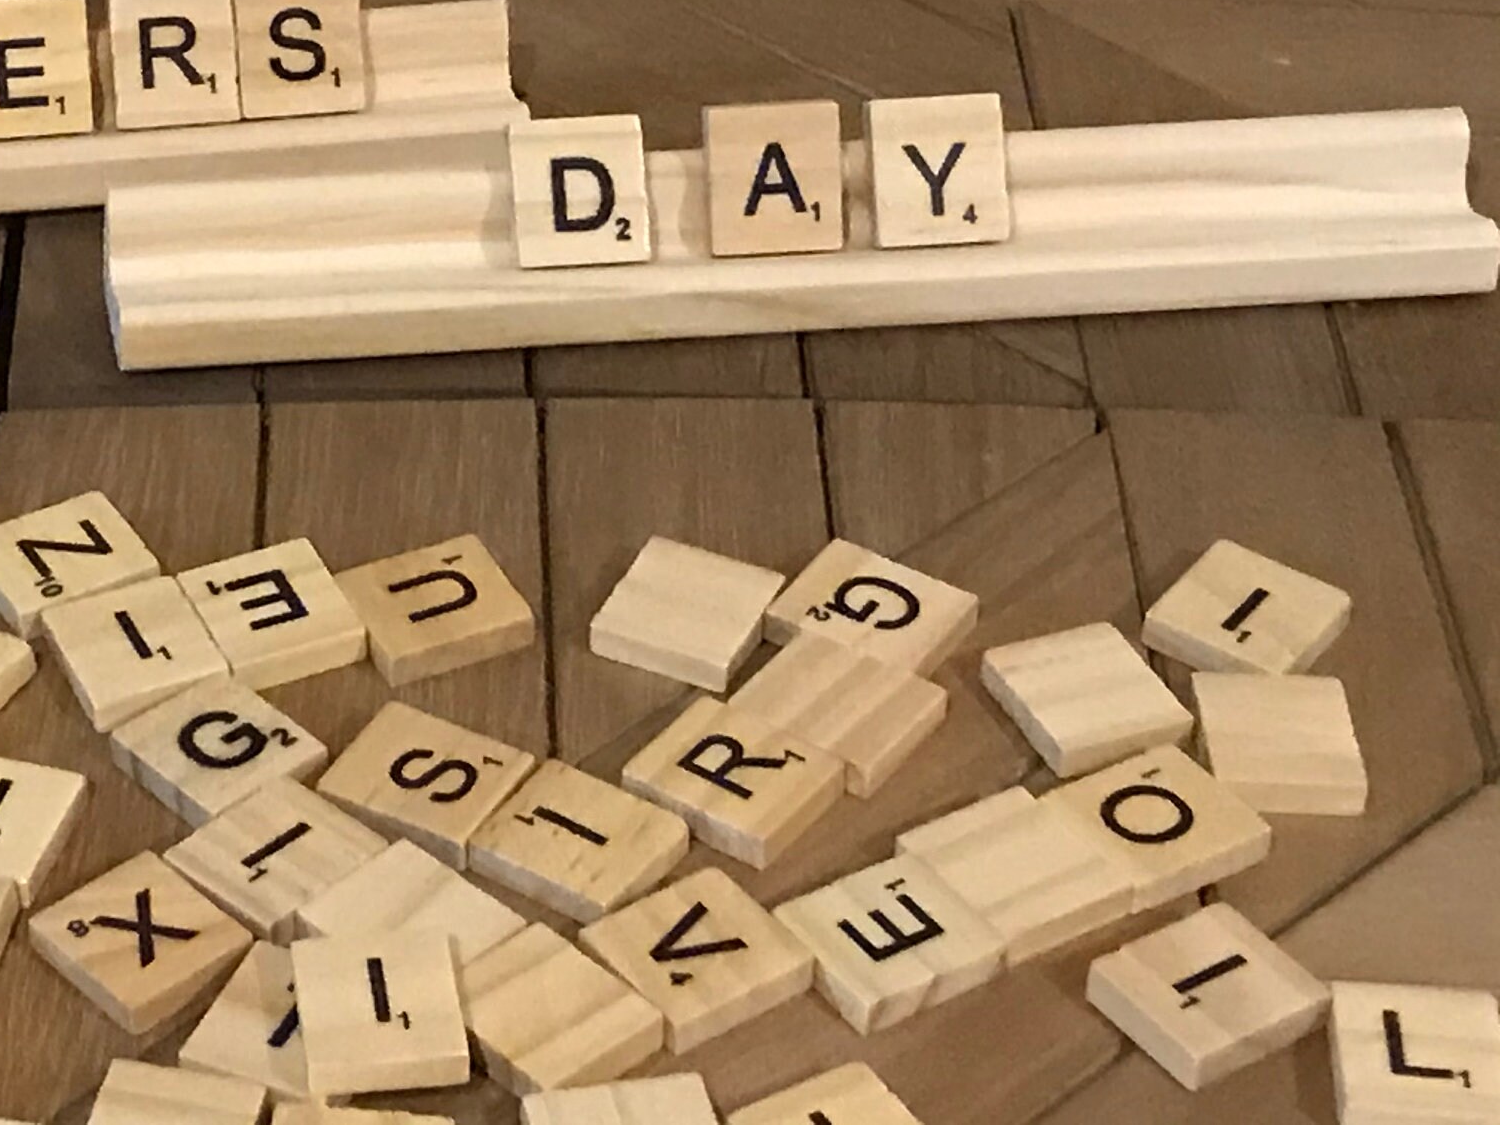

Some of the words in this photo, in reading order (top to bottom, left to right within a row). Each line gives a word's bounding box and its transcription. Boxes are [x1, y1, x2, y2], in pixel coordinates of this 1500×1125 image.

[550, 142, 965, 232] DAY
[16, 520, 113, 580] Z
[224, 569, 309, 631] E
[388, 570, 478, 623] U
[834, 577, 920, 630] G
[177, 711, 269, 769] G
[676, 733, 786, 800] R
[389, 749, 478, 803] S
[1100, 785, 1194, 844] O
[91, 888, 200, 968] X
[649, 901, 748, 963] V
[837, 894, 944, 962] E
[1383, 1010, 1454, 1079] L
